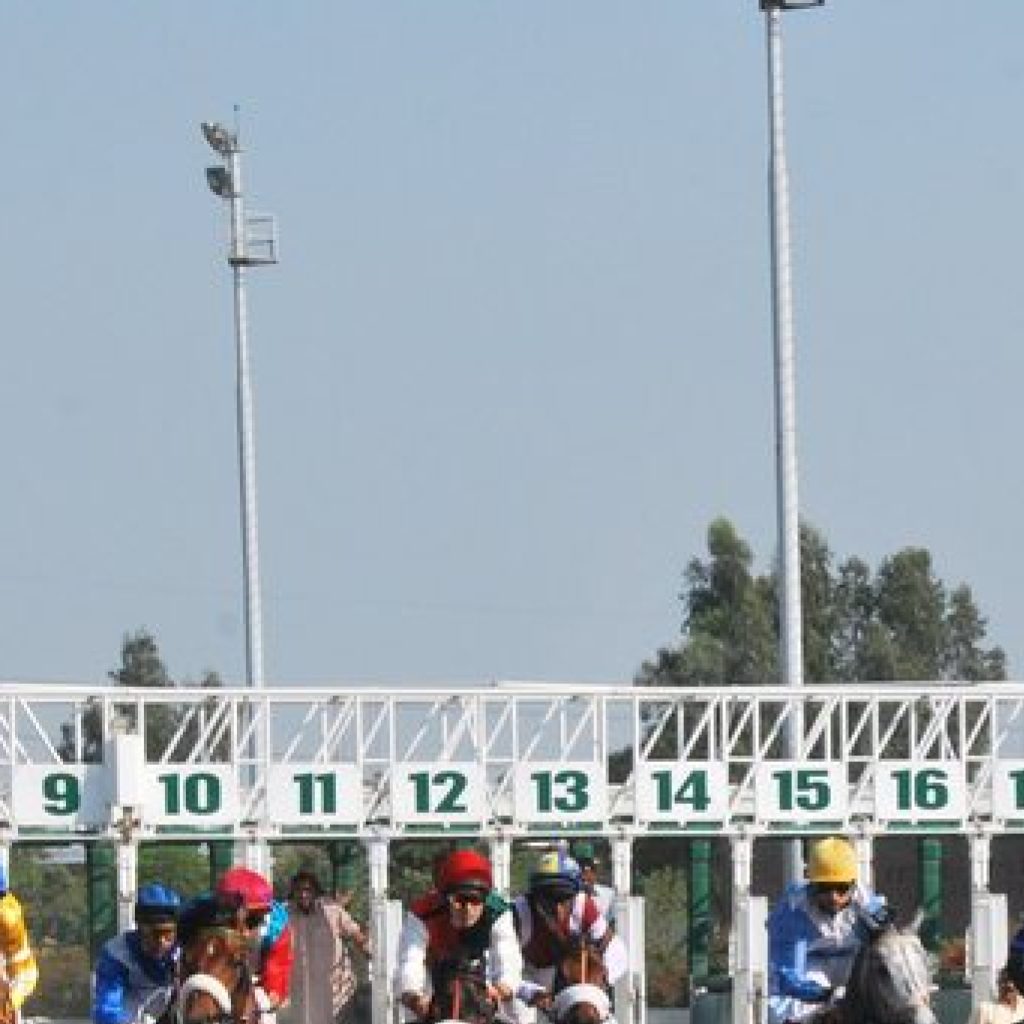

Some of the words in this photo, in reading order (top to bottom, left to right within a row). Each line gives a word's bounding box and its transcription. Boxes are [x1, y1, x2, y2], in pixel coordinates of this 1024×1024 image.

[42, 773, 81, 815] 9
[159, 773, 222, 815] 10
[292, 773, 338, 814] 11
[408, 772, 468, 814] 12
[531, 771, 590, 811] 13
[651, 771, 711, 812] 14
[771, 770, 832, 811] 15
[891, 769, 949, 811] 16
